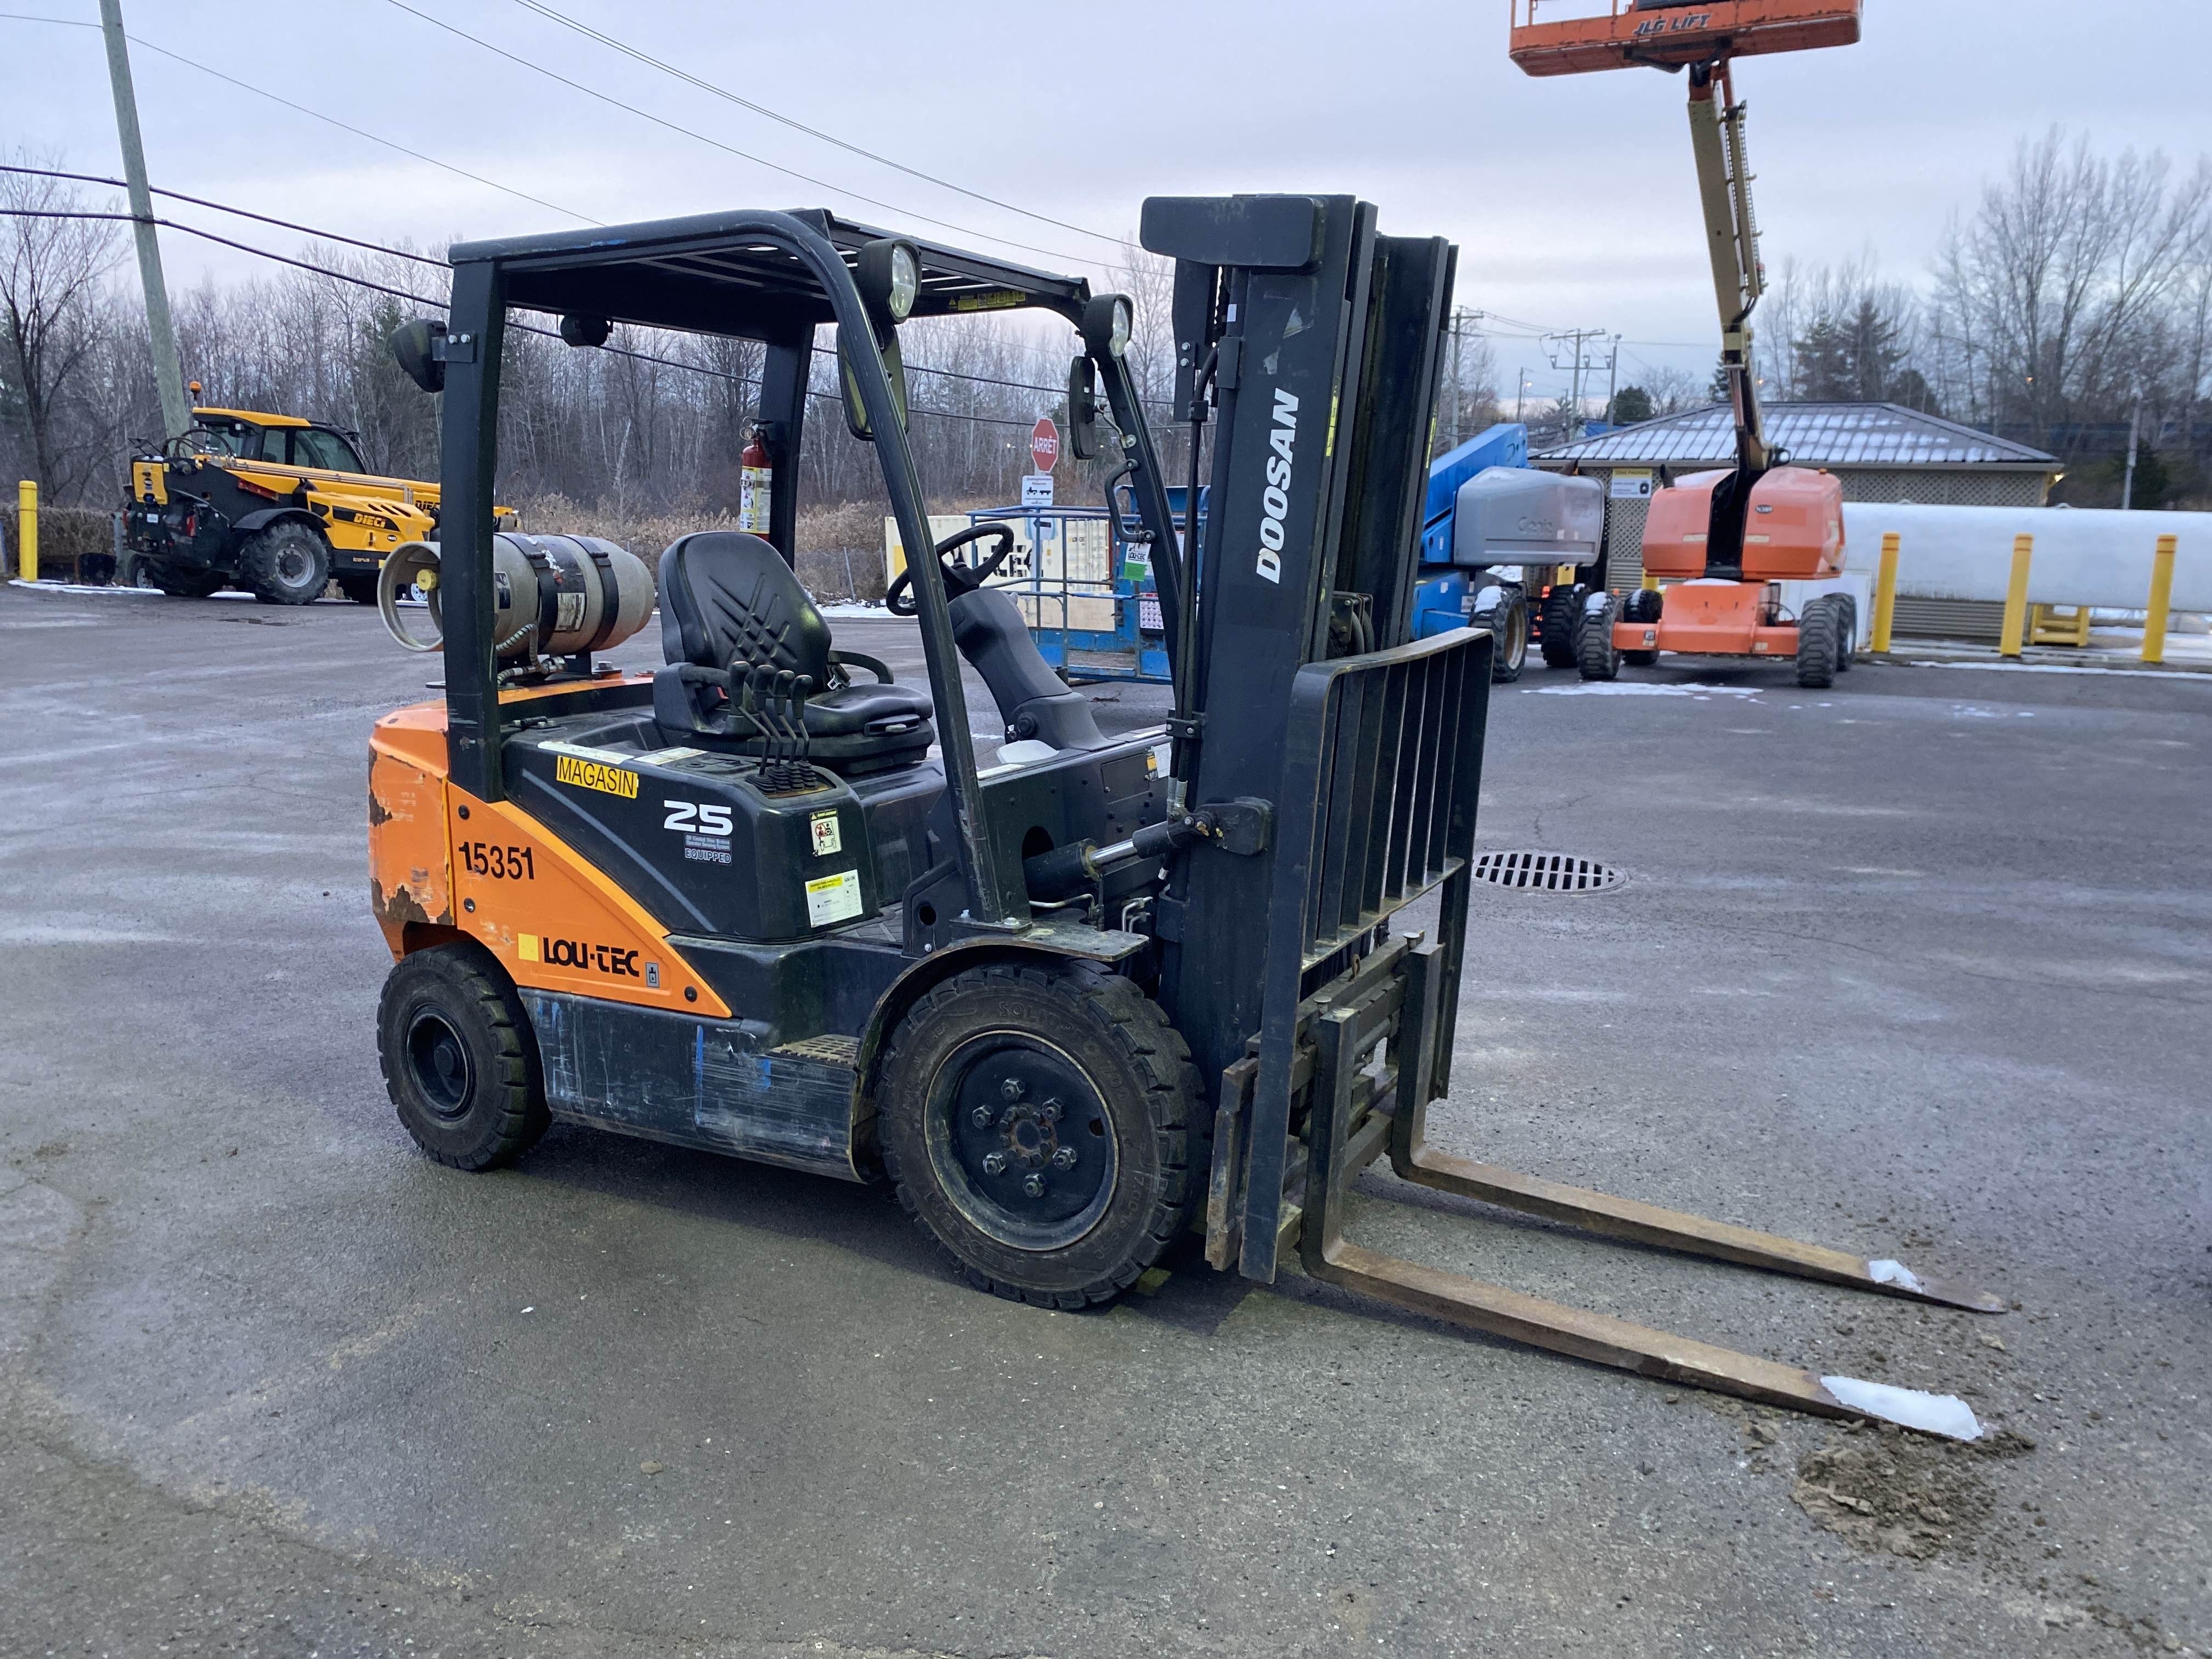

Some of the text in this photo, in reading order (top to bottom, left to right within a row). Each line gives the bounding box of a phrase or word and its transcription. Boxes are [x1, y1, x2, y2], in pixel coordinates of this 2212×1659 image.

[1633, 13, 1712, 36] JLG LIFT
[1034, 435, 1057, 454] ARRÊT
[1256, 387, 1299, 584] DOOSAN
[354, 513, 386, 528] DIECI
[559, 757, 634, 795] MAGASIN
[664, 800, 733, 836] 25
[459, 842, 534, 879] 15351
[685, 848, 731, 864] EQUIPPED
